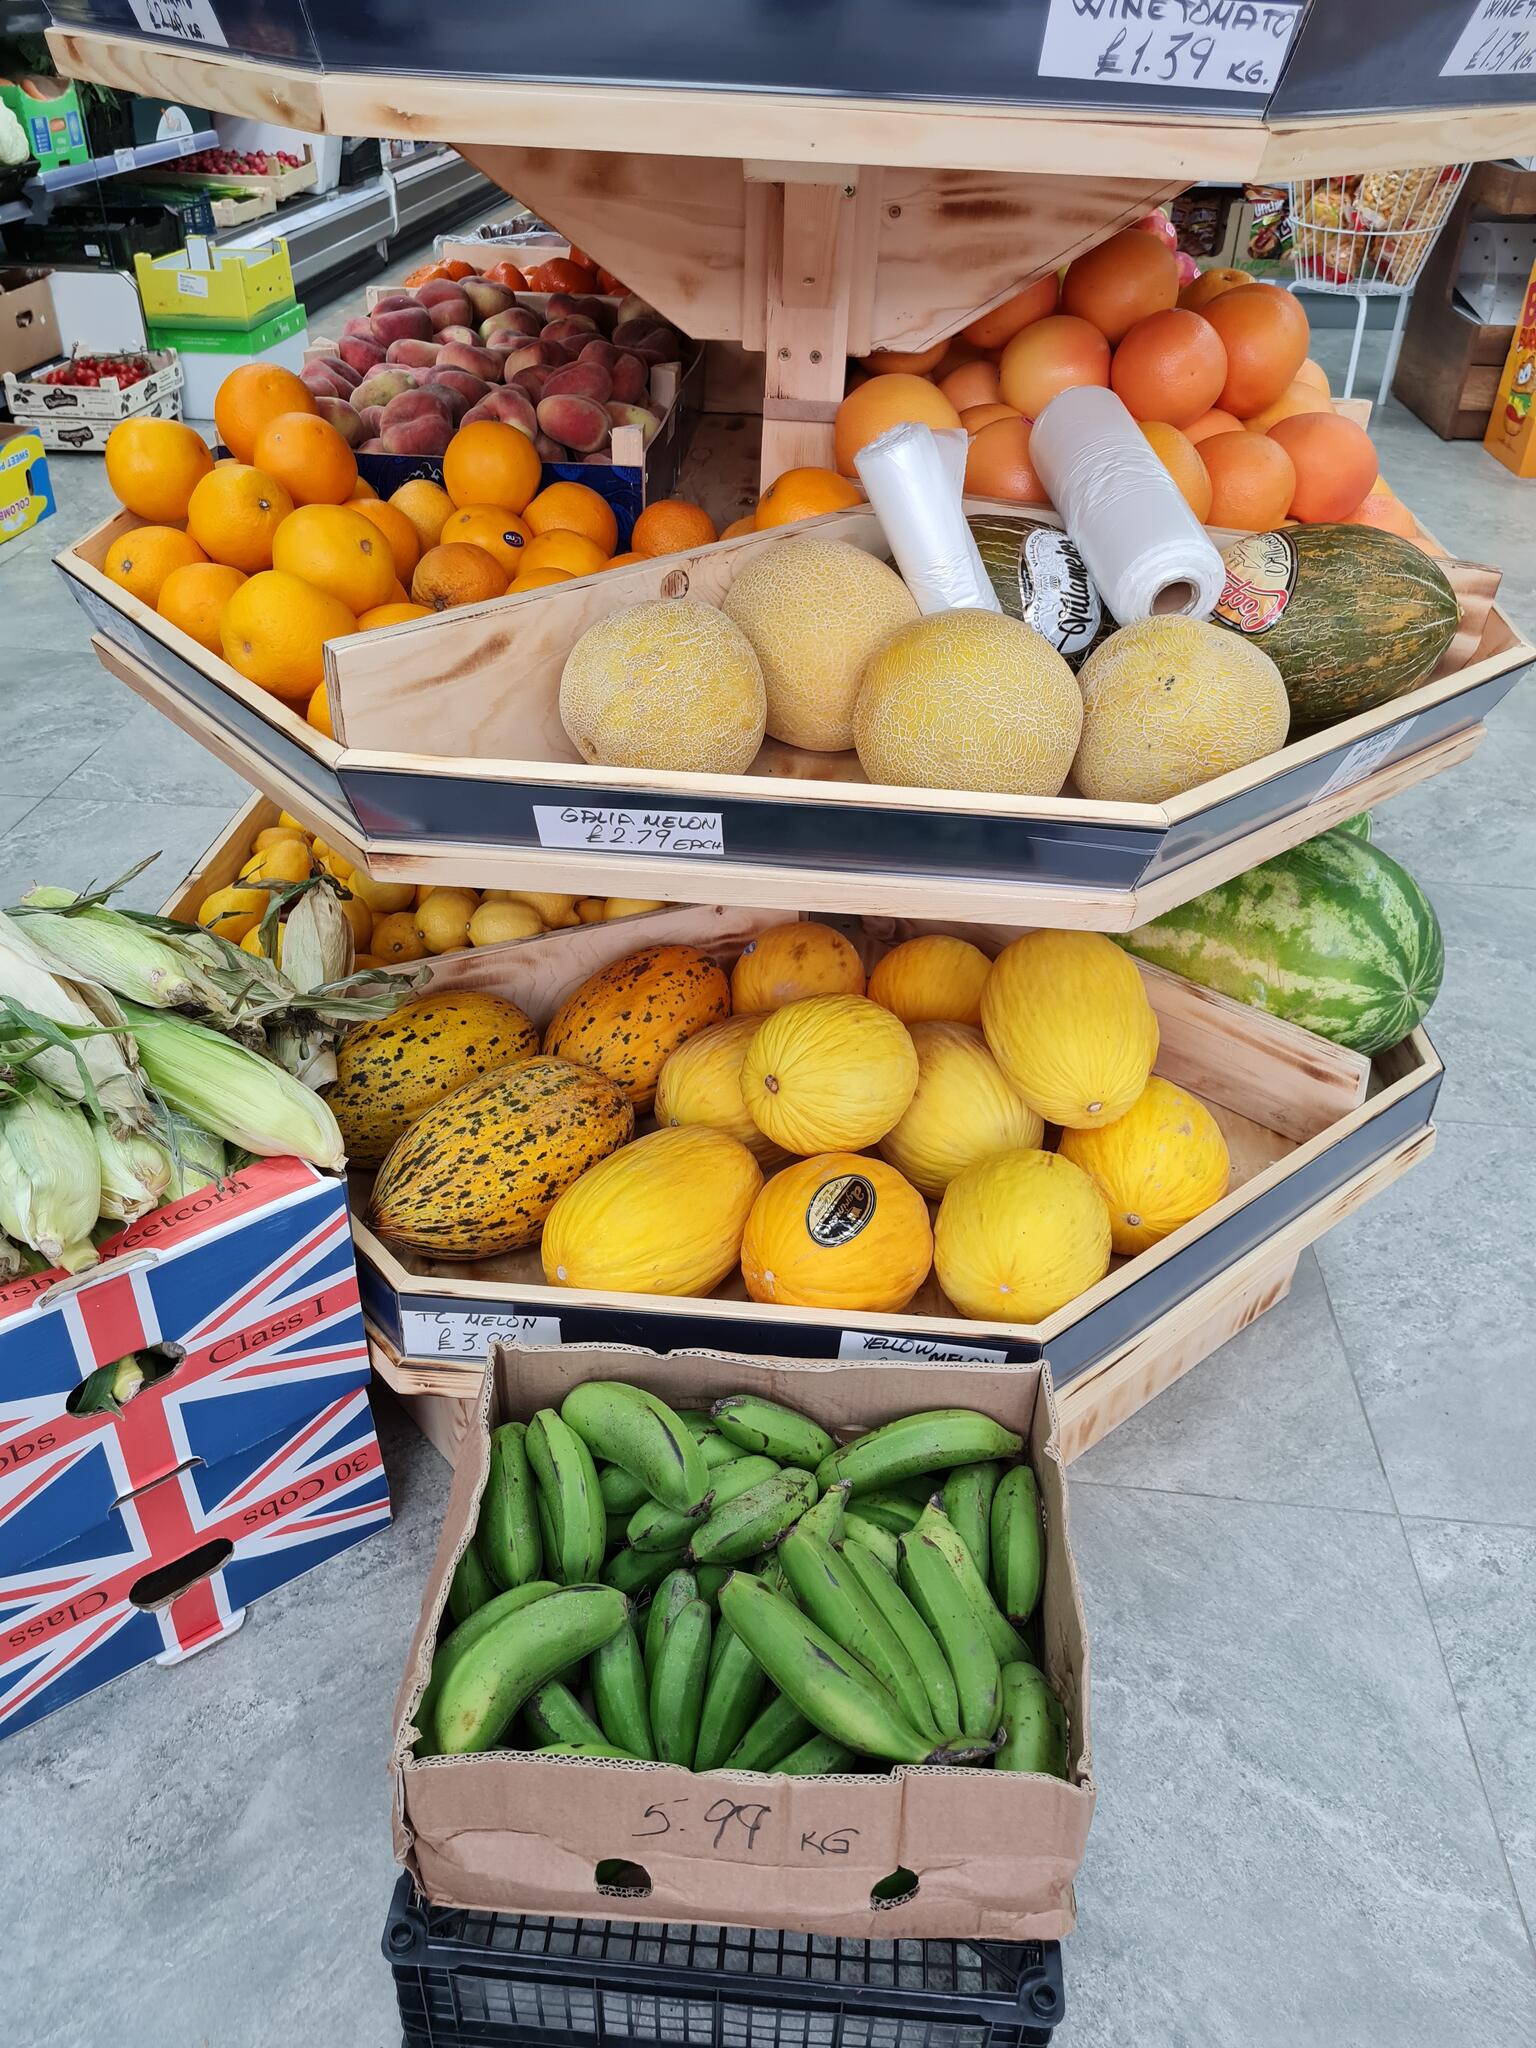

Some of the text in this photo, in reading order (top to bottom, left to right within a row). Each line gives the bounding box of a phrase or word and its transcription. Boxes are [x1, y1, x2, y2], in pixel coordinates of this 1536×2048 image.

[1094, 27, 1268, 86] £1.39 KG.
[560, 808, 716, 830] GALIA MELON
[586, 824, 722, 851] £2.79 EACH
[208, 1296, 327, 1364] Class I
[465, 1313, 537, 1330] MELON
[863, 1336, 938, 1354] YELLOW
[243, 1453, 369, 1526] 30 Cobs
[8, 1591, 109, 1648] Class
[800, 1828, 860, 1855] KG
